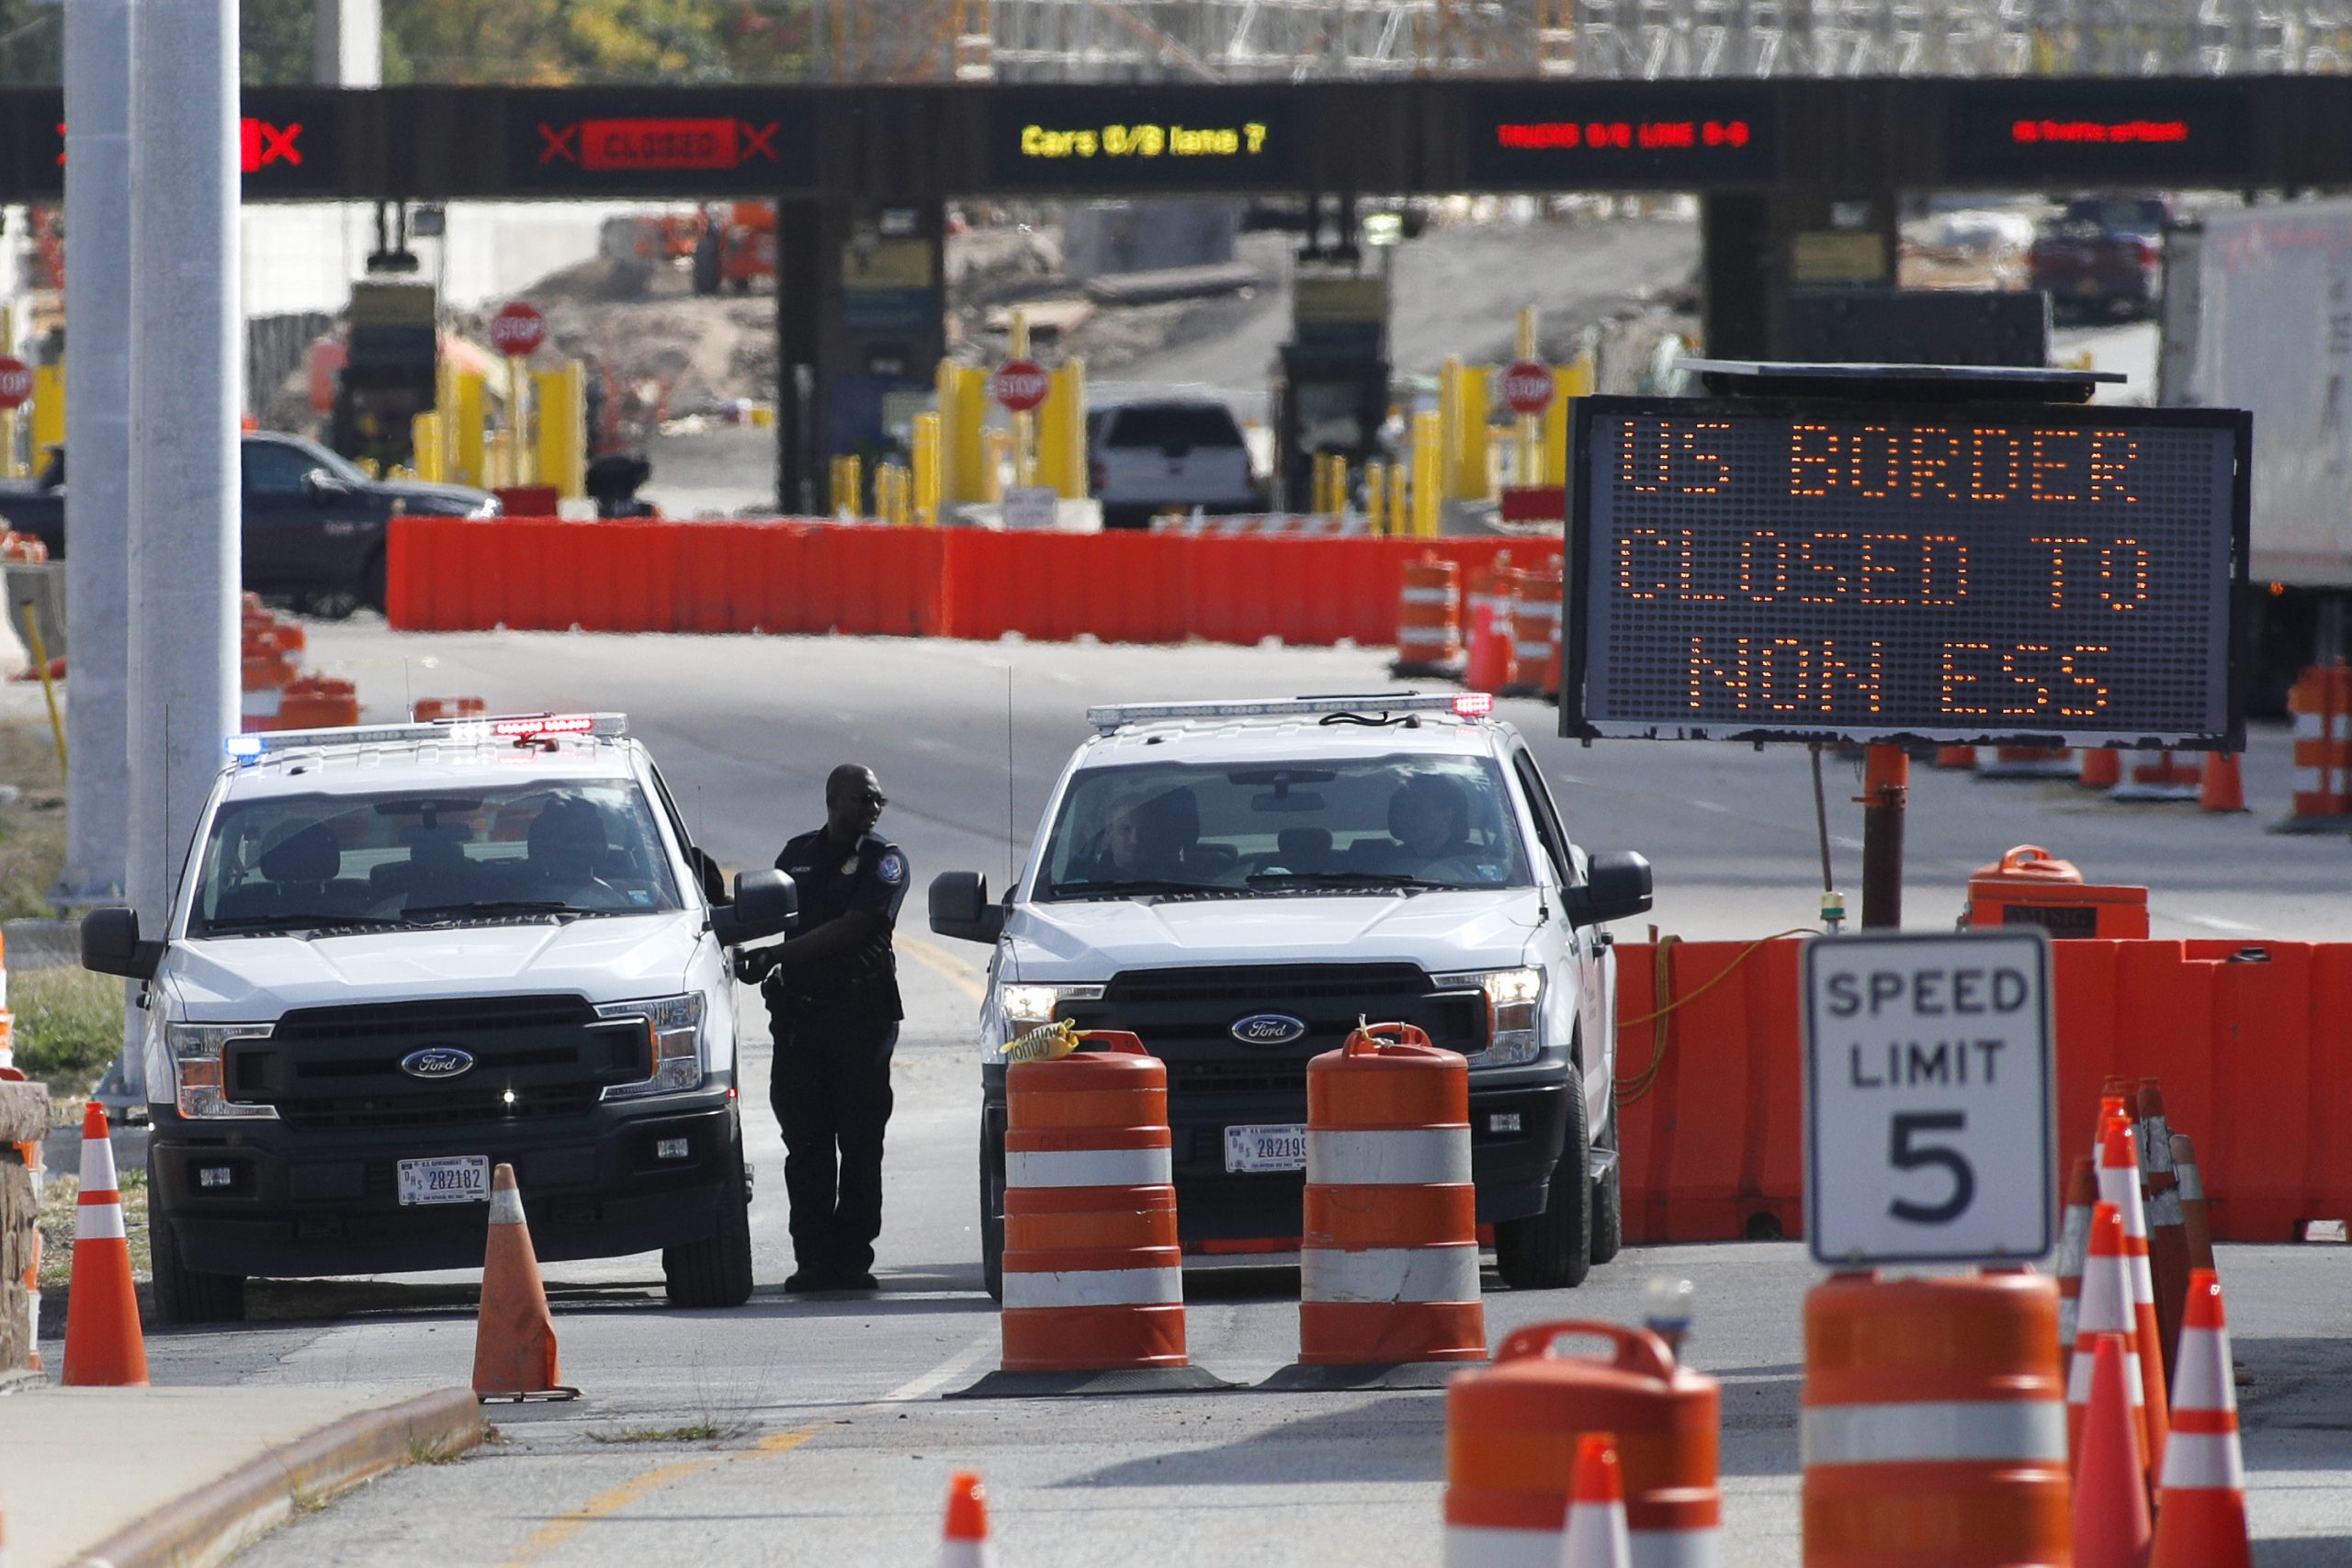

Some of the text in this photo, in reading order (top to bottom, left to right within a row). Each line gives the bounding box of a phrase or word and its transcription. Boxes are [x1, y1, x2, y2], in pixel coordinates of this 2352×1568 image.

[604, 131, 717, 158] CLOSED
[497, 316, 540, 340] STOP
[999, 374, 1045, 398] STOP
[1508, 377, 1551, 398] STOP
[1621, 420, 2139, 502] US BORDER
[1620, 527, 2151, 611] CLOSED TO
[1690, 637, 2109, 716] NON ESS
[1826, 968, 2029, 1018] SPEED
[1249, 1021, 1286, 1037] Ford
[419, 1054, 456, 1071] Ford
[1849, 1039, 2006, 1089] LIMIT
[429, 1168, 481, 1190] 282182
[1888, 1111, 1975, 1226] 5
